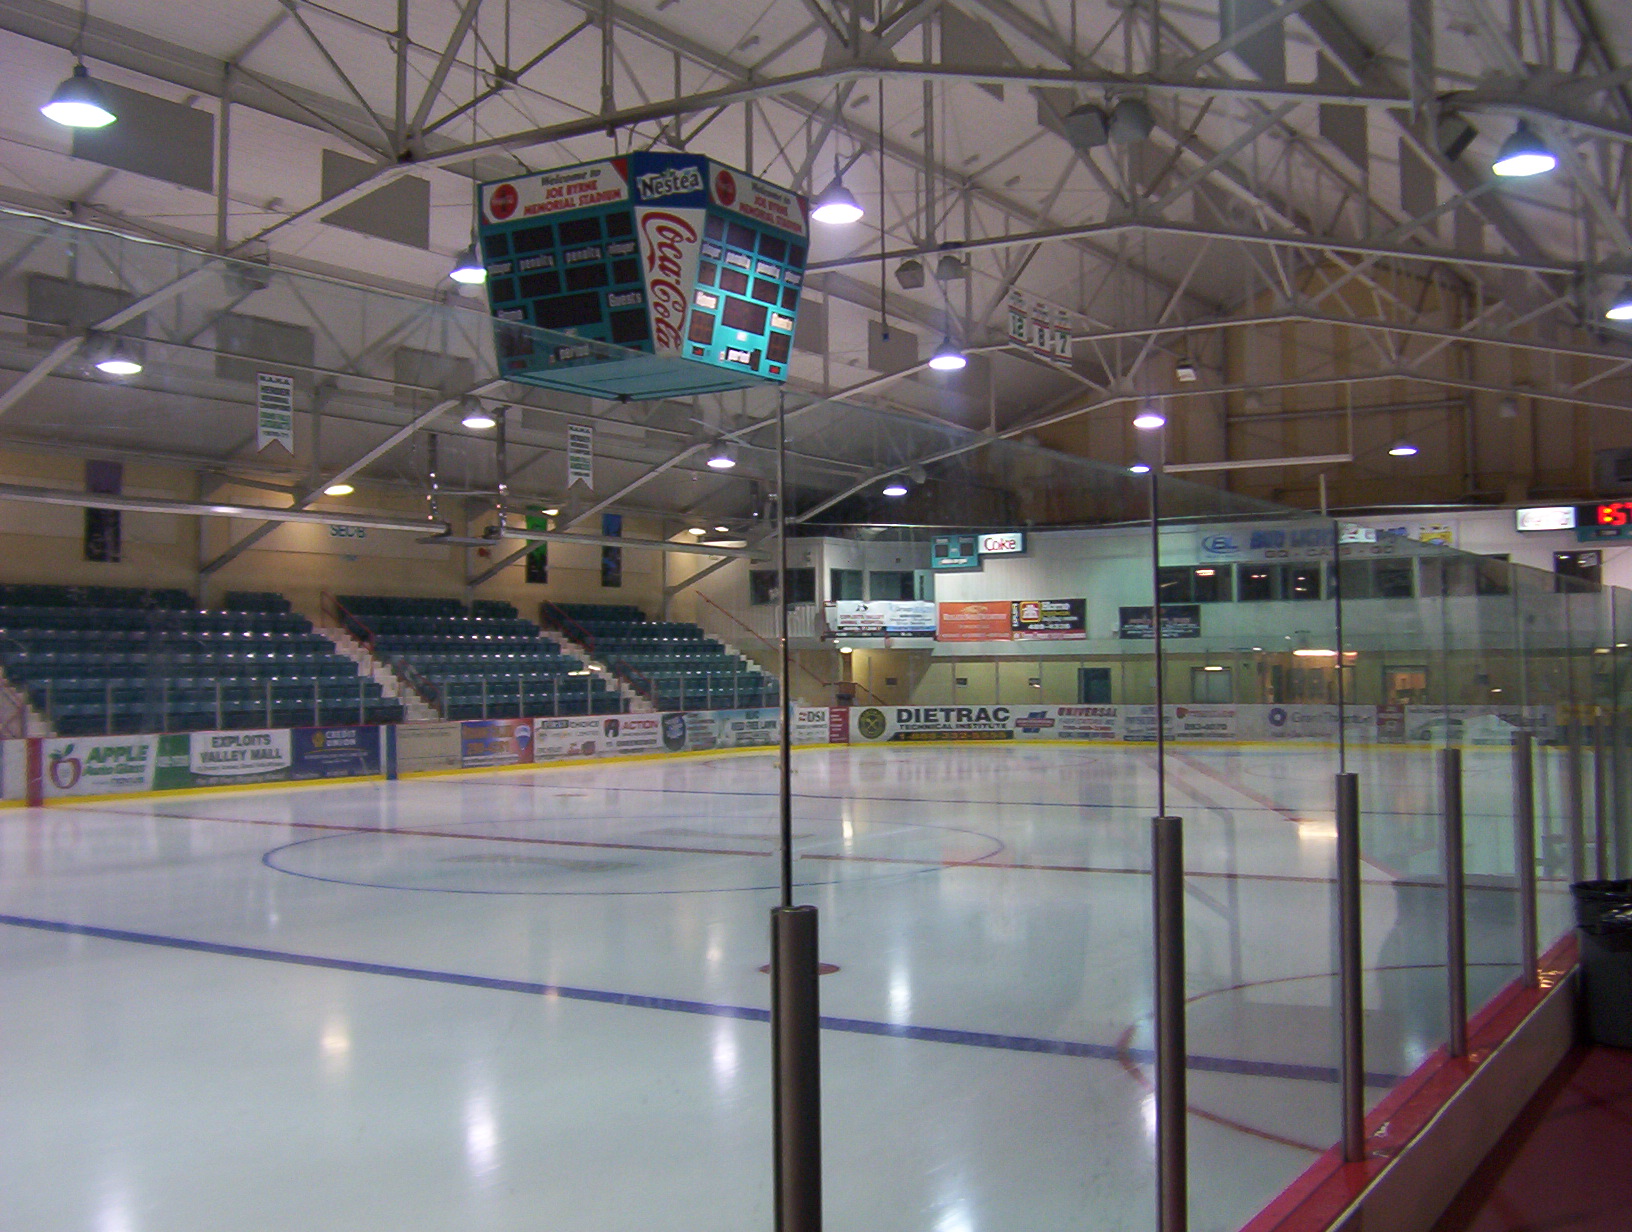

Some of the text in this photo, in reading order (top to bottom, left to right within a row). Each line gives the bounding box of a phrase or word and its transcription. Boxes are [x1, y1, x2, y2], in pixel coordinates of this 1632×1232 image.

[641, 171, 700, 197] Nestea
[546, 186, 564, 199] JOE
[523, 188, 622, 216] MEMORIAL STADIUM
[983, 537, 1017, 551] Coke
[896, 706, 1011, 723] DIETRAC
[621, 719, 659, 730] ACTION
[955, 722, 1007, 730] INSTITUTE
[211, 733, 272, 749] EXPLOITS
[86, 744, 149, 764] APPLE
[200, 749, 247, 763] VALLEY
[249, 747, 283, 761] MALL
